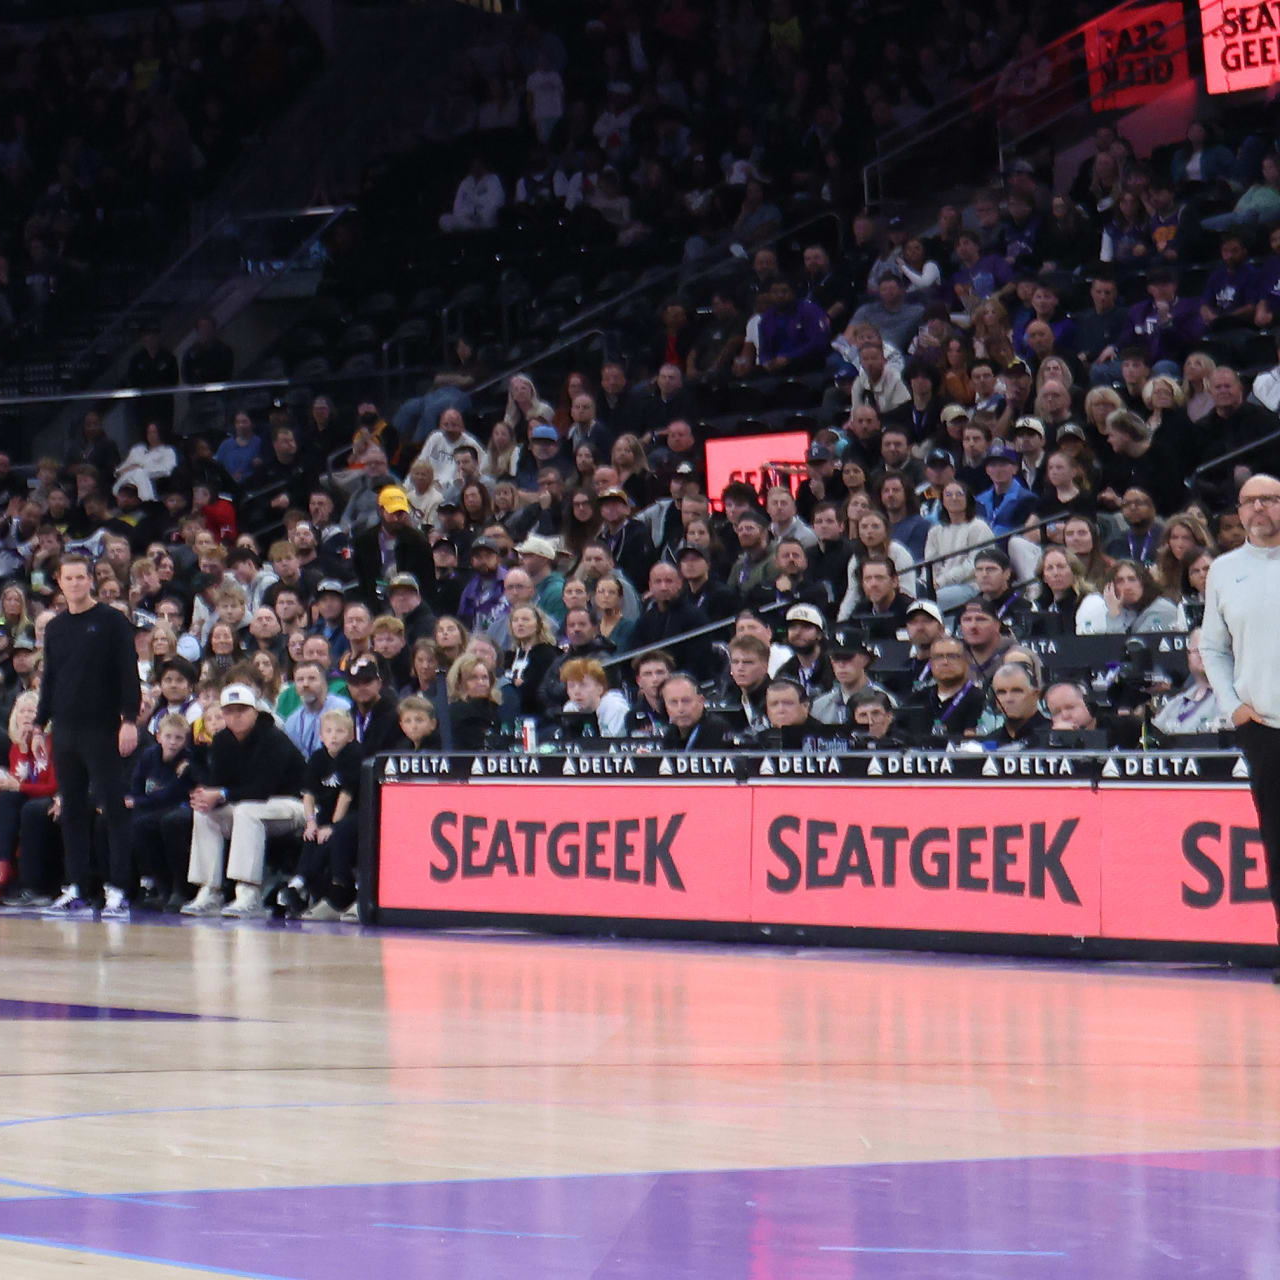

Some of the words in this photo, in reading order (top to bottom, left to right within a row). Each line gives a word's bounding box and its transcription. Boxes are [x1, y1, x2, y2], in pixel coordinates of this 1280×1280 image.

[401, 757, 449, 775] DELTA
[487, 756, 538, 775] DELTA
[581, 756, 635, 775] DELTA
[674, 757, 735, 775] DELTA
[778, 756, 839, 775] DELTA
[888, 756, 953, 775] DELTA
[1004, 756, 1073, 776] DELTA
[1124, 756, 1199, 777] DELTA
[429, 811, 686, 892] SEATGEEK
[766, 814, 1082, 906] SEATGEEK
